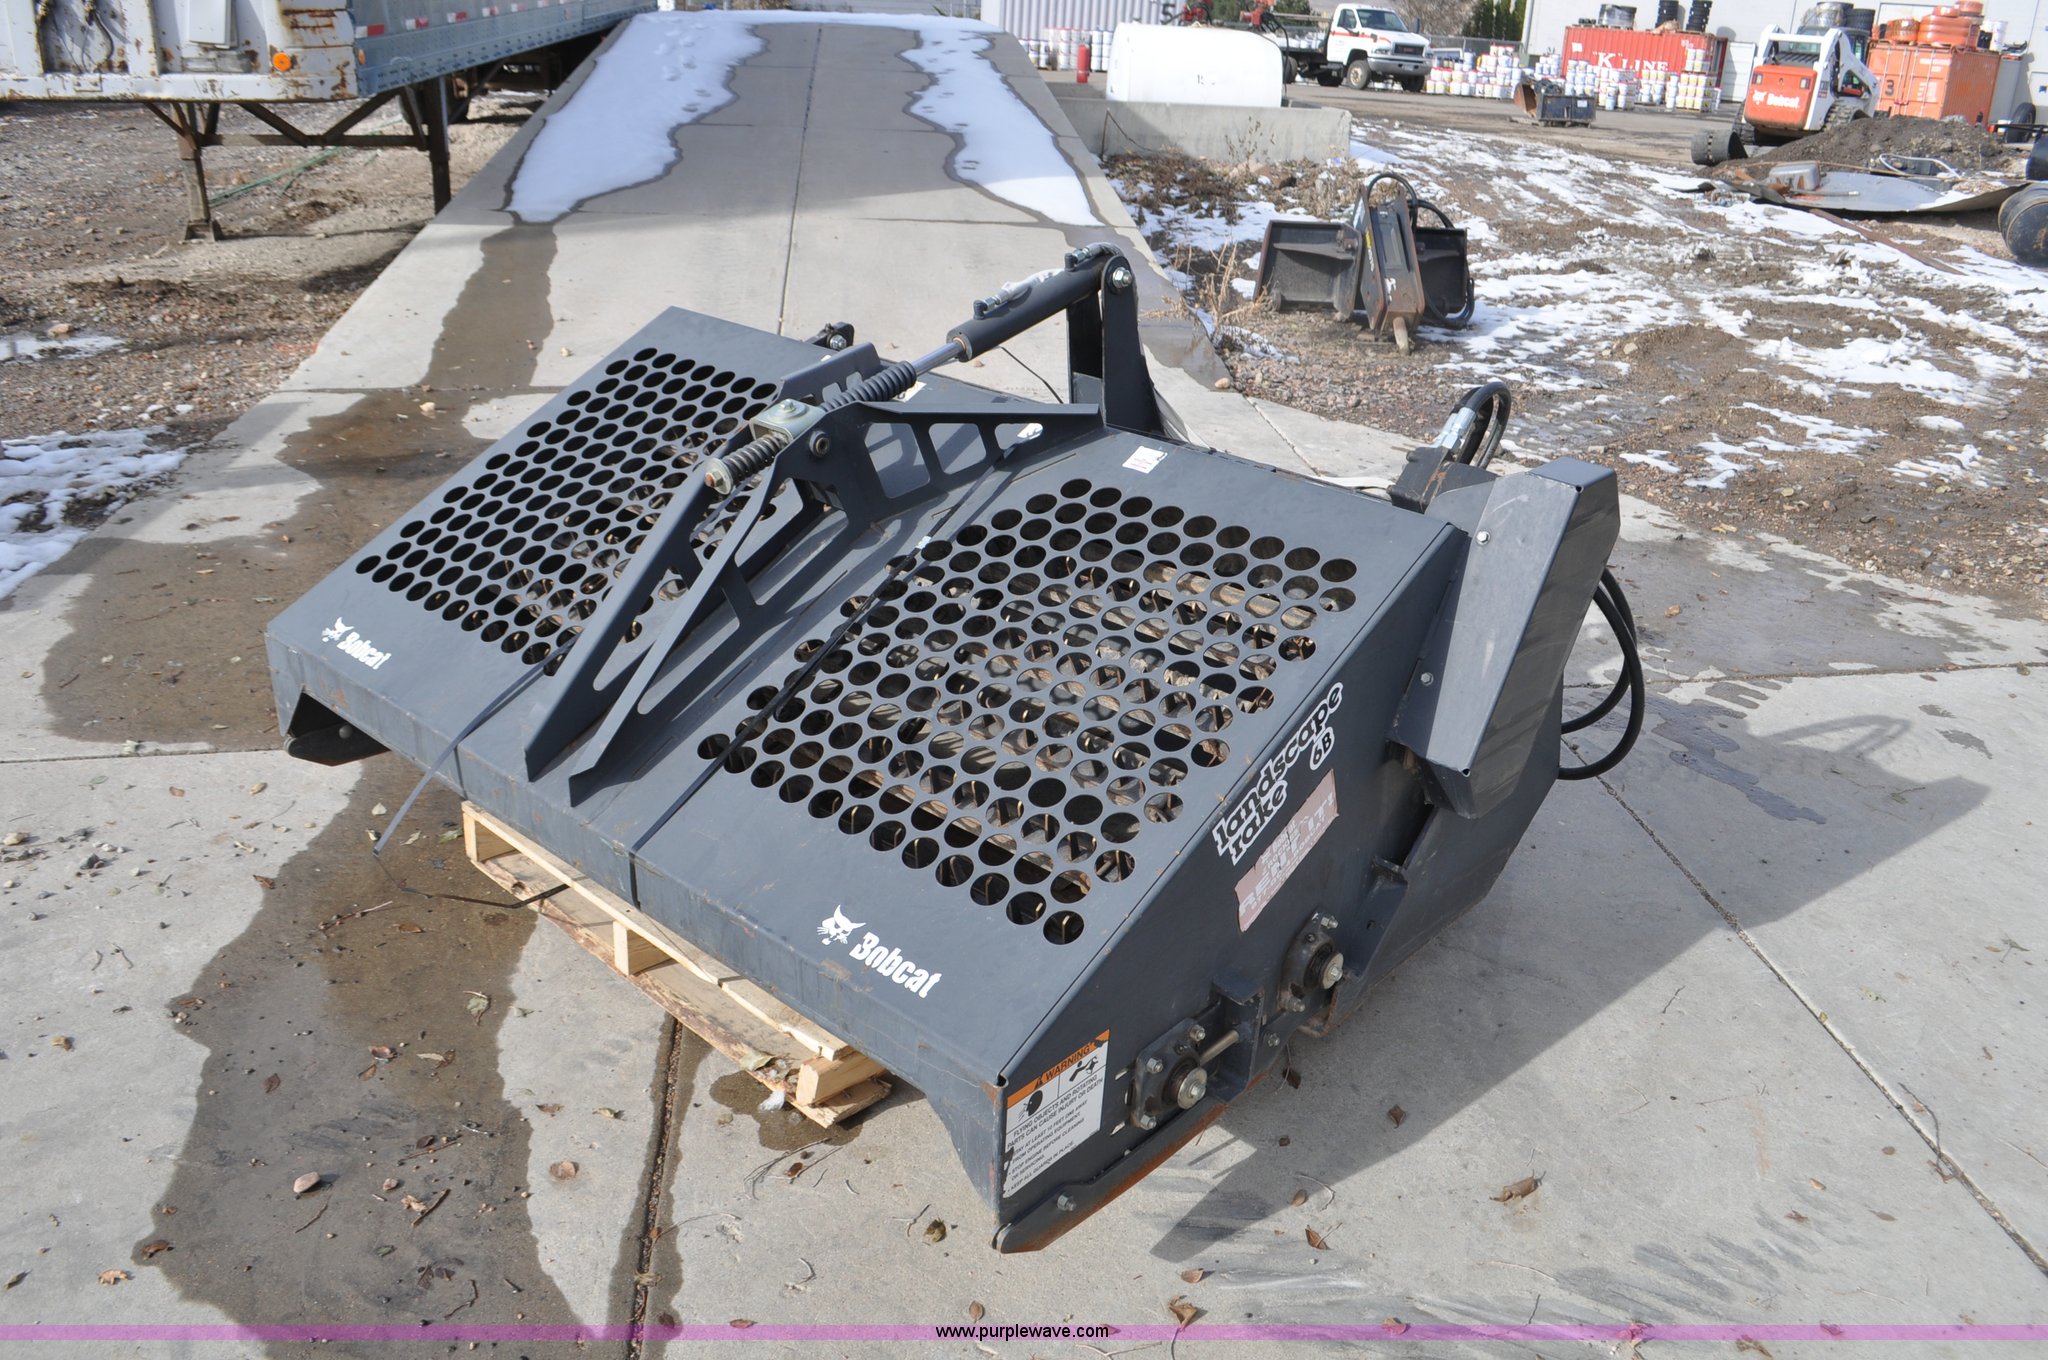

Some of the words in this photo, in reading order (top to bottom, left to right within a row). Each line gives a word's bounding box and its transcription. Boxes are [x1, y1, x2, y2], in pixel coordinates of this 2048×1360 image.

[1622, 58, 1668, 71] LINE
[1767, 93, 1800, 109] Bobcat
[1885, 79, 1895, 96] 3
[336, 631, 392, 670] Bobcat
[1212, 682, 1344, 856] landscape
[1309, 727, 1335, 770] 6B
[1229, 780, 1288, 866] rake
[849, 931, 942, 998] Bobcat
[1045, 1043, 1090, 1082] WARNING
[1007, 1132, 1024, 1149] PARTS
[1026, 1123, 1037, 1136] CAN
[1039, 1110, 1055, 1127] CAUSE
[1058, 1095, 1077, 1113] INJURY
[1078, 1088, 1086, 1099] OR
[1013, 1119, 1032, 1137] FLYING
[1034, 1101, 1058, 1123] OBJECTS
[1059, 1092, 1071, 1105] AND
[1072, 1073, 1097, 1096] ROTATING
